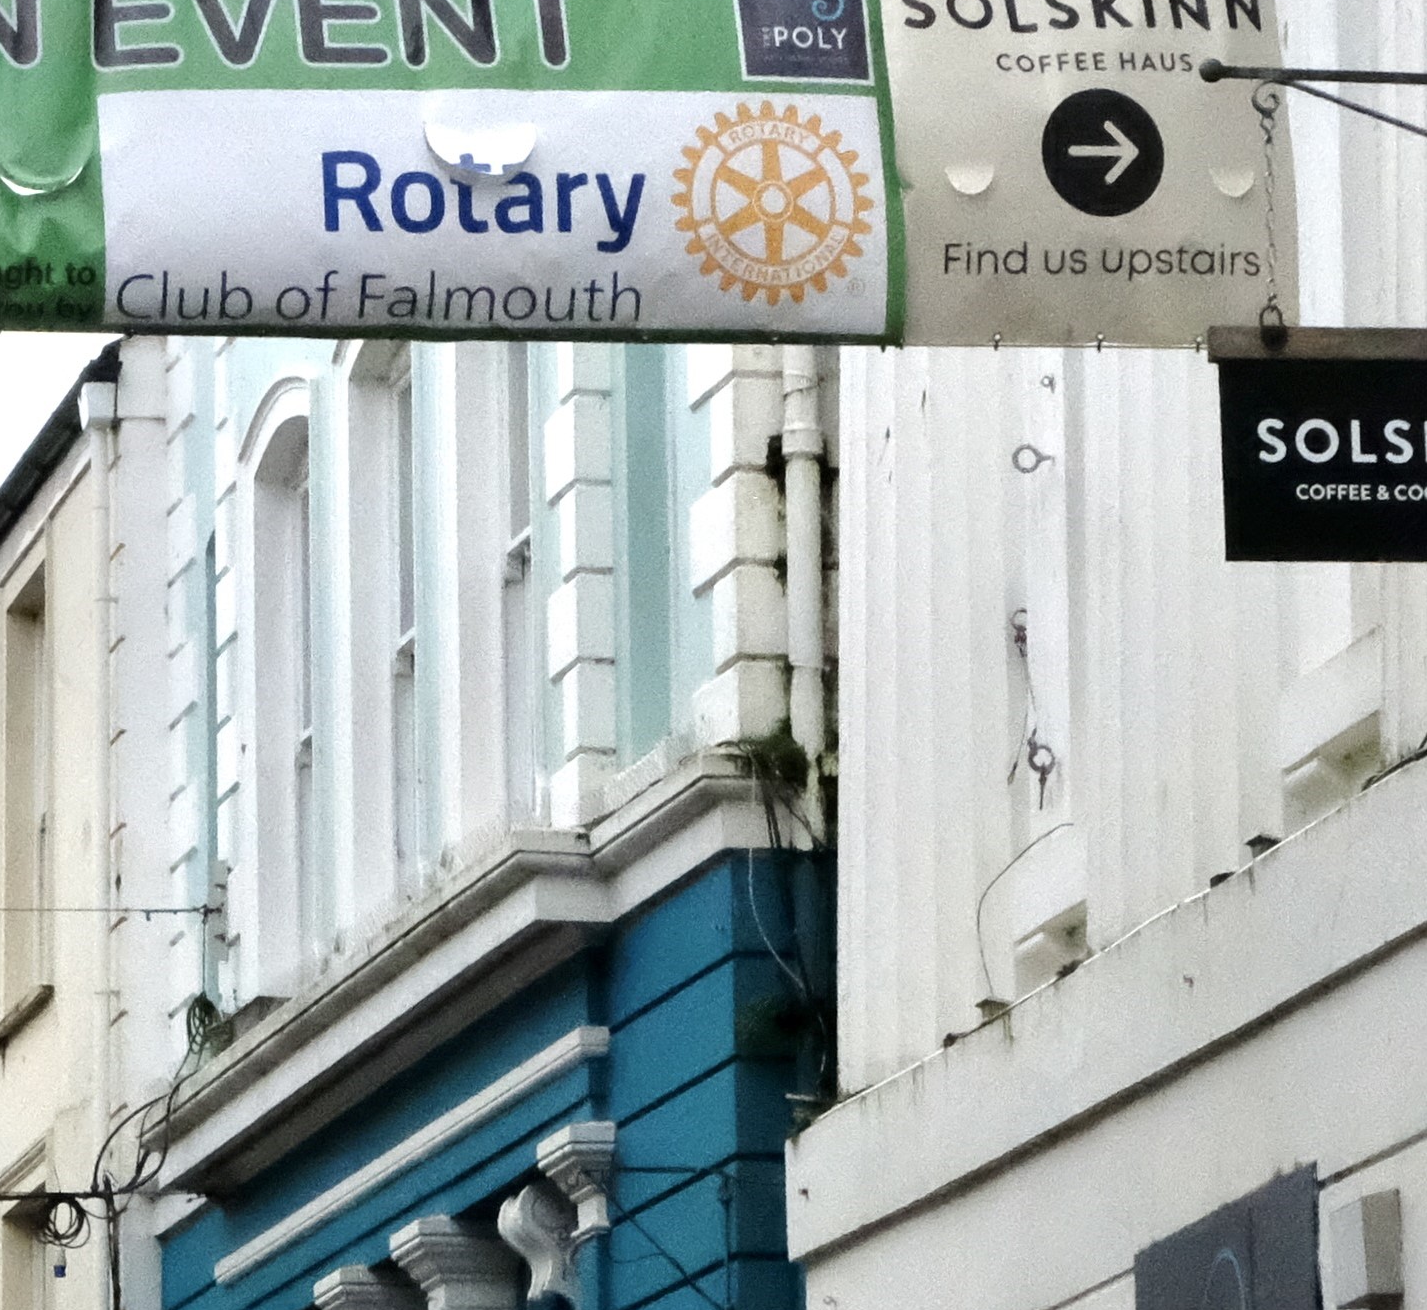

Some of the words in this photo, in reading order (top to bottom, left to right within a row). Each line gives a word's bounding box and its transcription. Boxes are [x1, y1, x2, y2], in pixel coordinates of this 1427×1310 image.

[773, 25, 848, 50] POLY
[995, 52, 1108, 74] COFFEE
[1119, 51, 1194, 74] HAUS
[728, 123, 812, 145] ROTARY
[320, 149, 646, 253] Rotary
[66, 261, 97, 286] to
[942, 242, 1029, 277] Find
[1043, 245, 1088, 276] us
[1100, 242, 1262, 281] upstairs
[115, 269, 253, 324] Club
[275, 268, 341, 322] of
[358, 269, 645, 325] Falmouth
[1256, 417, 1427, 464] SOLS
[1295, 483, 1372, 501] COFFEE
[1376, 484, 1390, 501] &
[1394, 483, 1427, 502] CO
